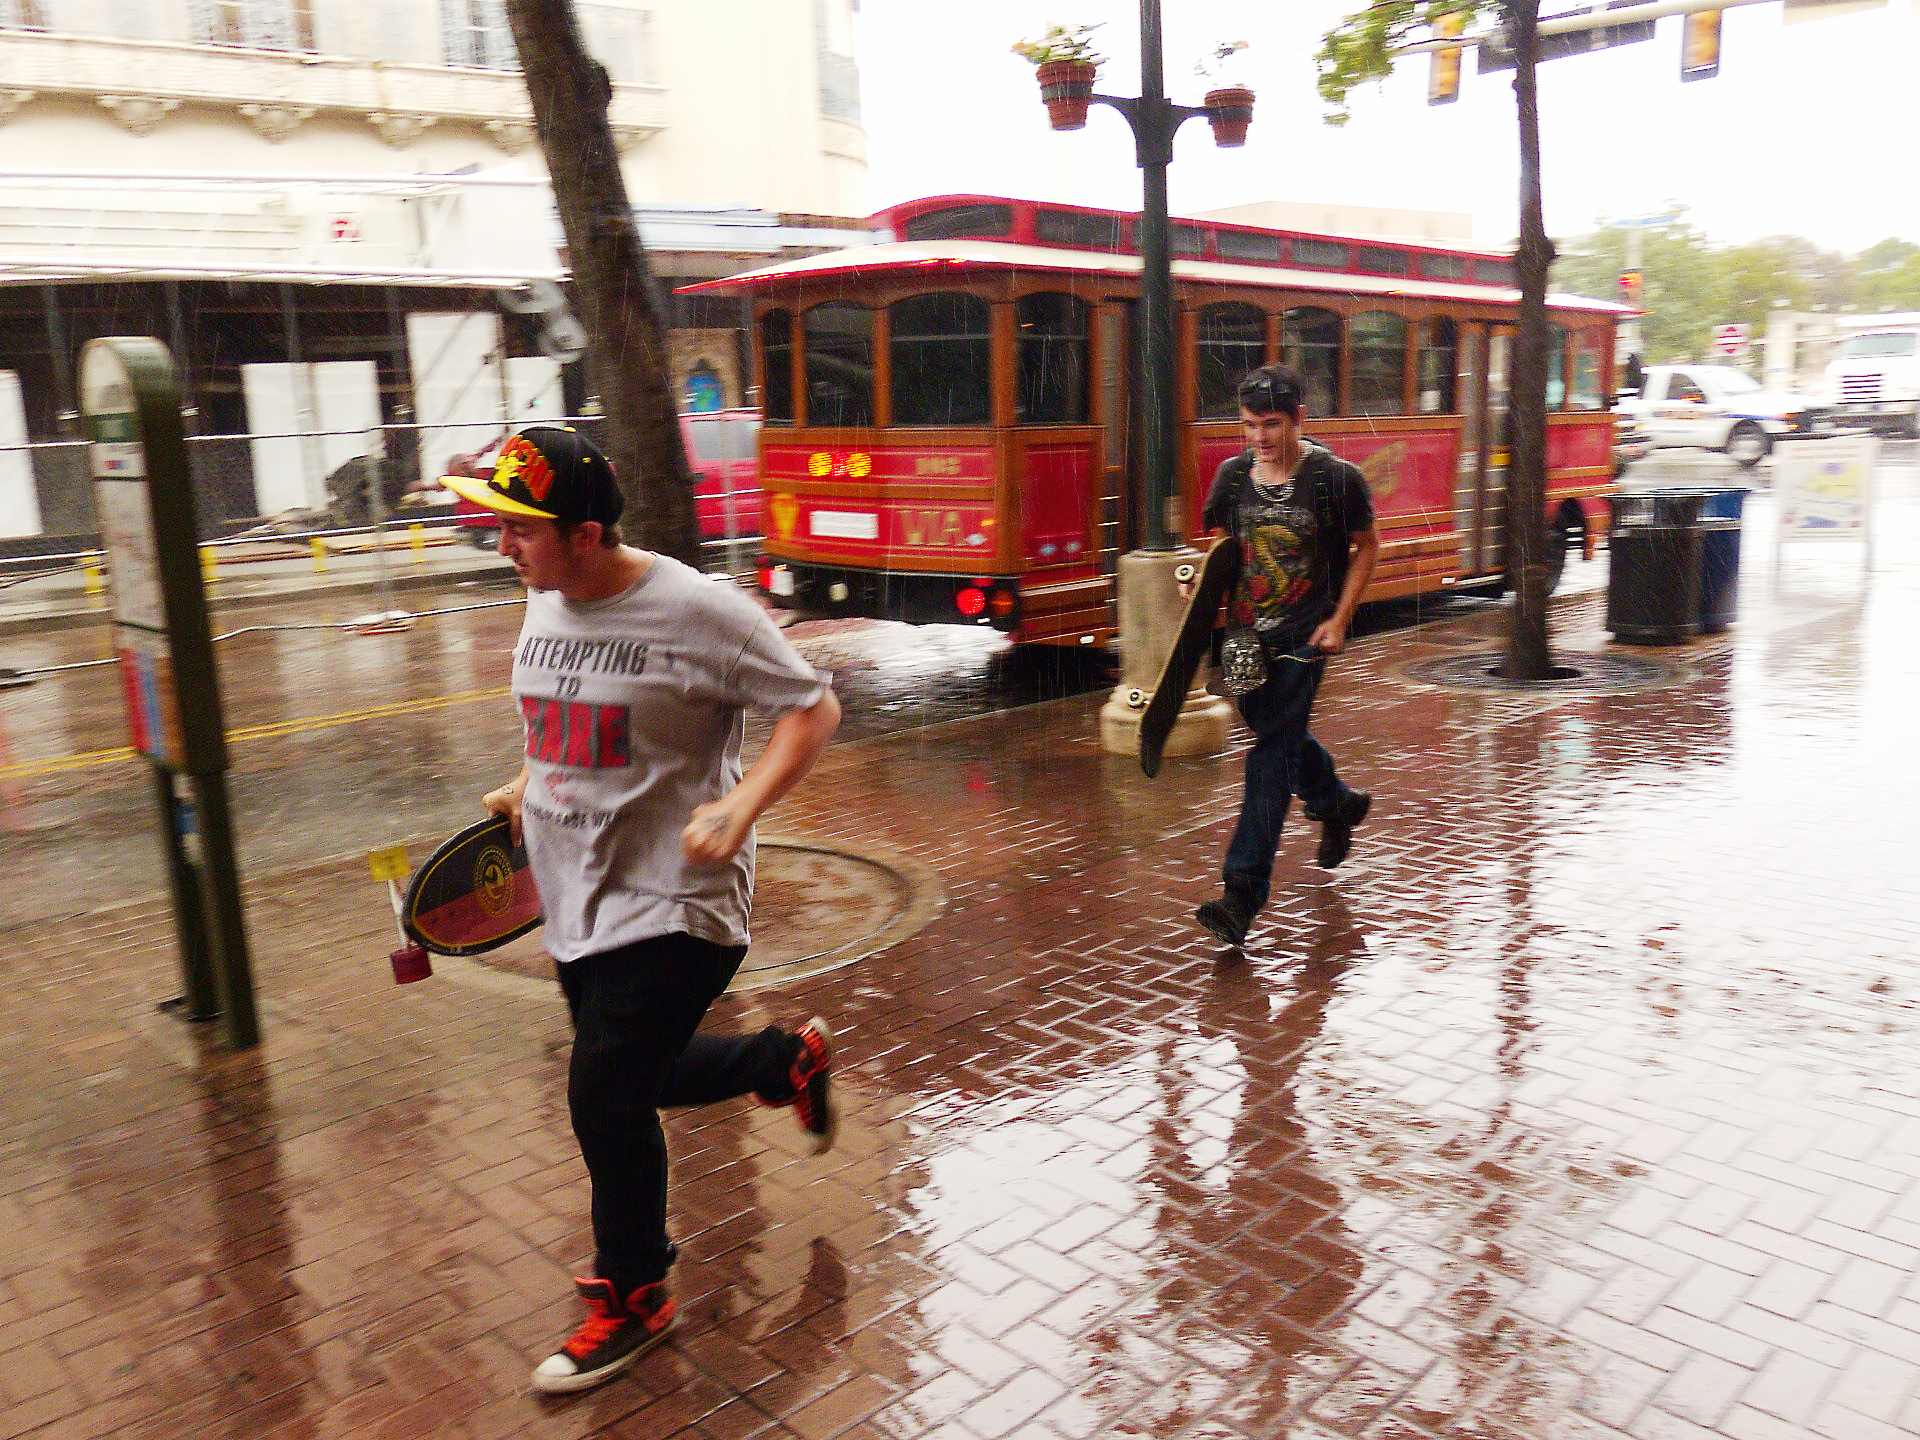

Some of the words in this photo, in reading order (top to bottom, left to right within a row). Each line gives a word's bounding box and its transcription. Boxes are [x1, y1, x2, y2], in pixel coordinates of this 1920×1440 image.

[896, 509, 969, 546] VIA
[519, 636, 648, 676] ATTEMPTING
[555, 675, 582, 697] TO
